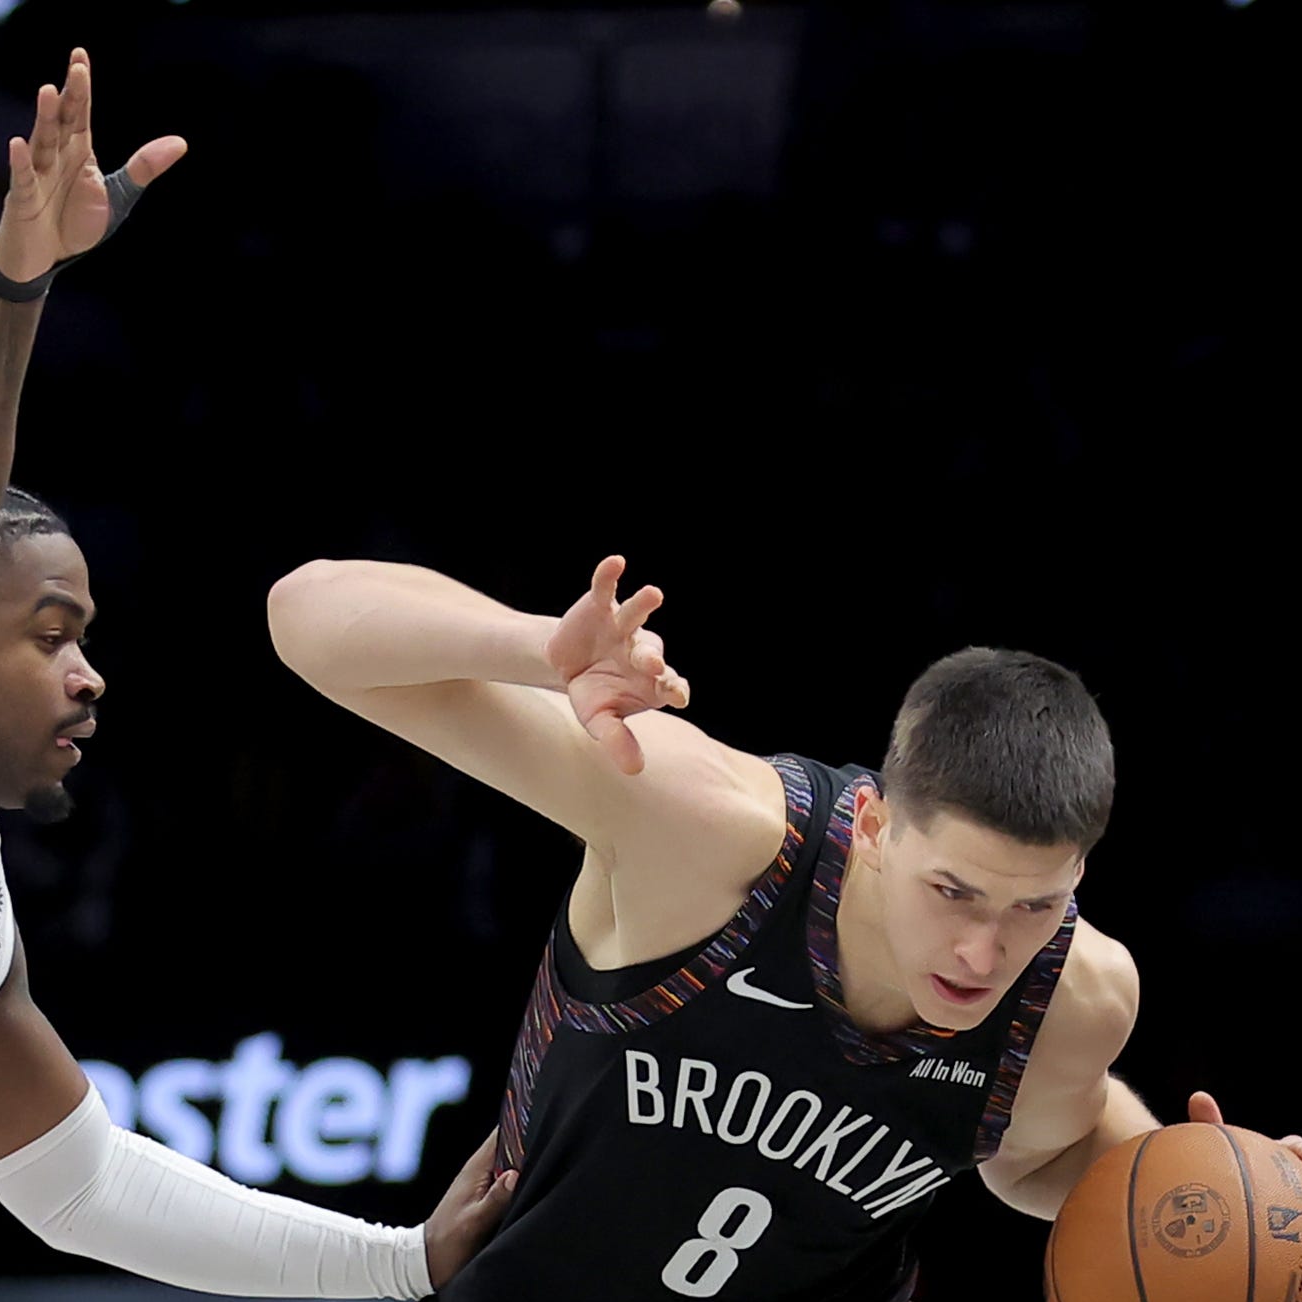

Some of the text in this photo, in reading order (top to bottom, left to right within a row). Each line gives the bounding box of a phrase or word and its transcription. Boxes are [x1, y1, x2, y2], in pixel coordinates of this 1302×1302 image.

[909, 1058, 987, 1089] All In Won
[624, 1049, 952, 1220] BROOKLYN
[660, 1186, 773, 1299] 8
